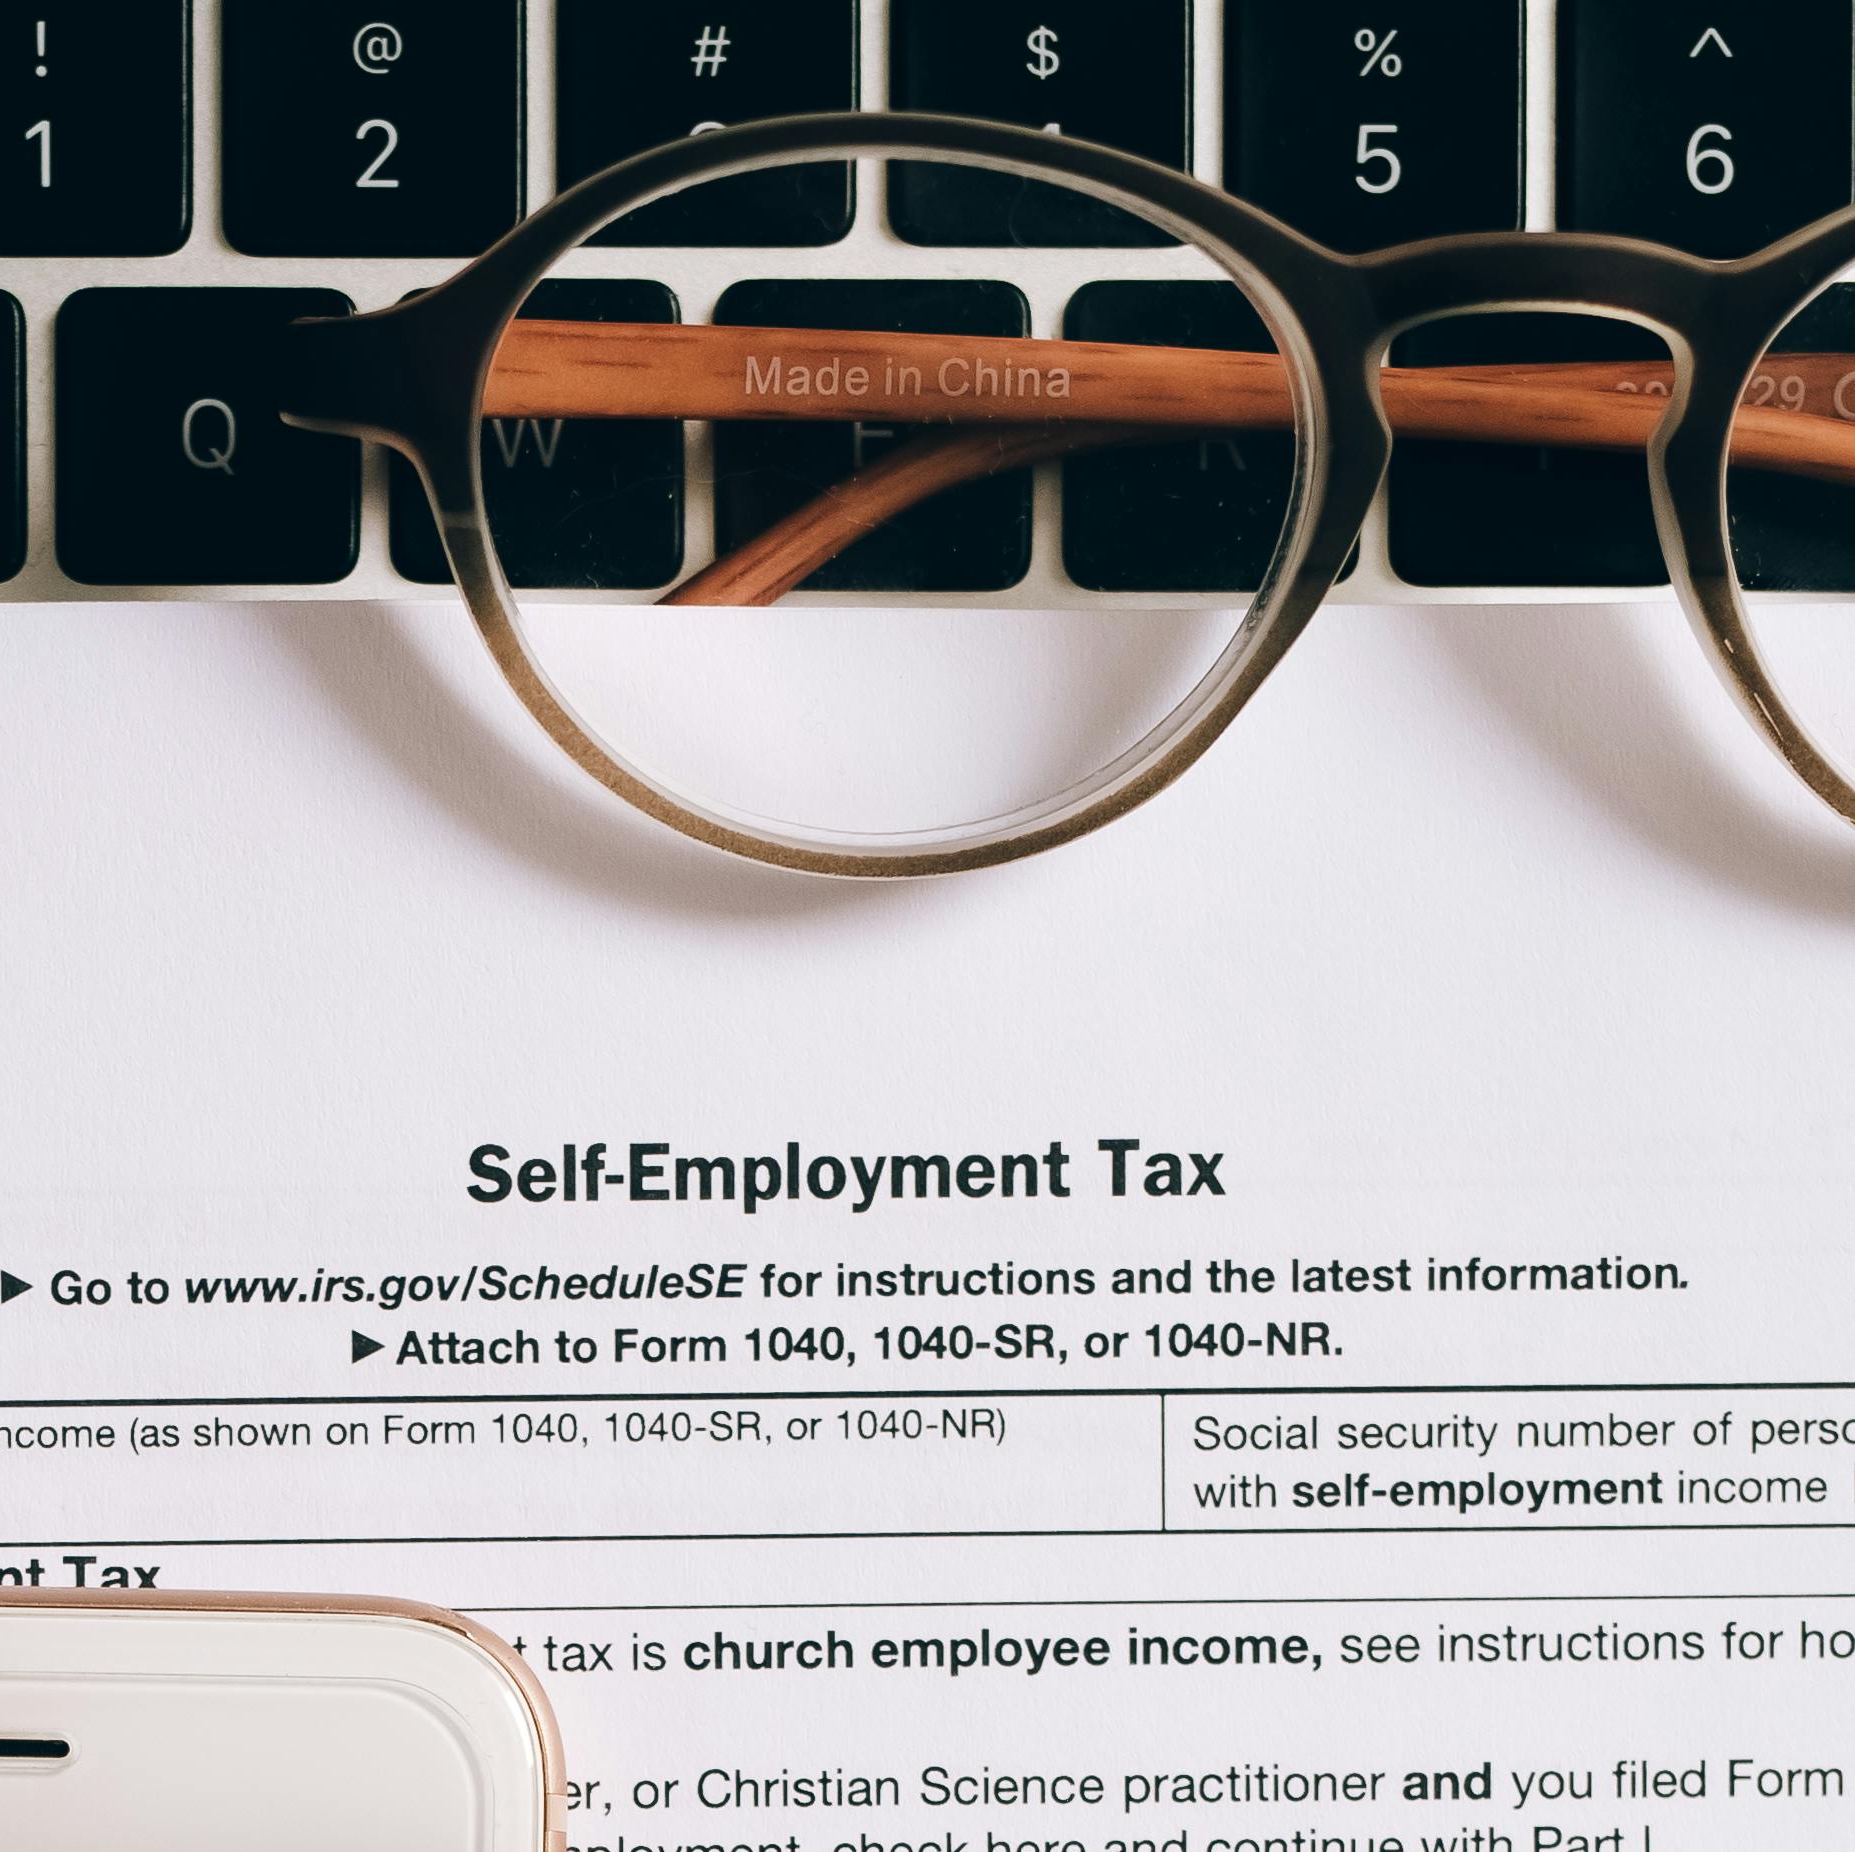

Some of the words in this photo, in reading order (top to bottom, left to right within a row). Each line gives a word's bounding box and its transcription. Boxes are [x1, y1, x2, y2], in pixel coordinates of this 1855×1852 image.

[26, 120, 50, 187] 1
[356, 119, 398, 187] 2
[1356, 125, 1400, 193] 5
[1687, 124, 1734, 194] 6
[745, 355, 870, 397] Made
[885, 357, 922, 397] in
[938, 357, 1071, 398] China
[183, 399, 235, 473] Q
[467, 1142, 1070, 1214] Self-Employment
[1098, 1139, 1225, 1196] Tax
[51, 1270, 111, 1305] Go
[127, 1272, 169, 1304] to
[186, 1264, 747, 1310] www.irs.gov/ScheduleSE
[760, 1264, 822, 1297] for
[838, 1261, 1095, 1296] instructions
[1112, 1260, 1191, 1294] and
[1206, 1260, 1275, 1293] the
[1293, 1259, 1411, 1292] latest
[1429, 1256, 1687, 1291] information.
[396, 1330, 539, 1365] Attach
[555, 1331, 597, 1363] to
[615, 1329, 726, 1362] Form
[746, 1327, 855, 1367] 1040,
[875, 1324, 1067, 1364] 1040-SR,
[1085, 1333, 1129, 1358] or
[1146, 1322, 1342, 1357] 1040-NR.
[131, 1418, 179, 1455] (as
[194, 1417, 310, 1446] shown
[327, 1423, 368, 1445] on
[385, 1415, 474, 1444] Form
[493, 1413, 587, 1446] 1040,
[606, 1411, 770, 1444] 1040-SR,
[787, 1418, 822, 1440] or
[838, 1409, 1005, 1445] 1040-NR)
[1194, 1416, 1317, 1450] Social
[1338, 1415, 1497, 1456] security
[1518, 1413, 1675, 1447] number
[1694, 1411, 1732, 1445] of
[1194, 1474, 1276, 1507] with
[1293, 1472, 1662, 1514] self-employment
[1679, 1478, 1827, 1503] income
[63, 1556, 160, 1588] Tax
[544, 1636, 613, 1671] tax
[633, 1642, 666, 1670] is
[684, 1631, 853, 1670] church
[872, 1629, 1110, 1676] employee
[1130, 1627, 1321, 1671] income,
[1341, 1635, 1420, 1663] see
[1440, 1623, 1704, 1662] instructions
[1722, 1622, 1783, 1659] for
[634, 1780, 678, 1809] or
[698, 1768, 898, 1808] Christian
[921, 1767, 1104, 1805] Science
[1125, 1764, 1385, 1813] practitioner
[1403, 1762, 1491, 1800] and
[1512, 1771, 1591, 1809] you
[1613, 1760, 1705, 1798] filed
[1729, 1759, 1843, 1797] Form
